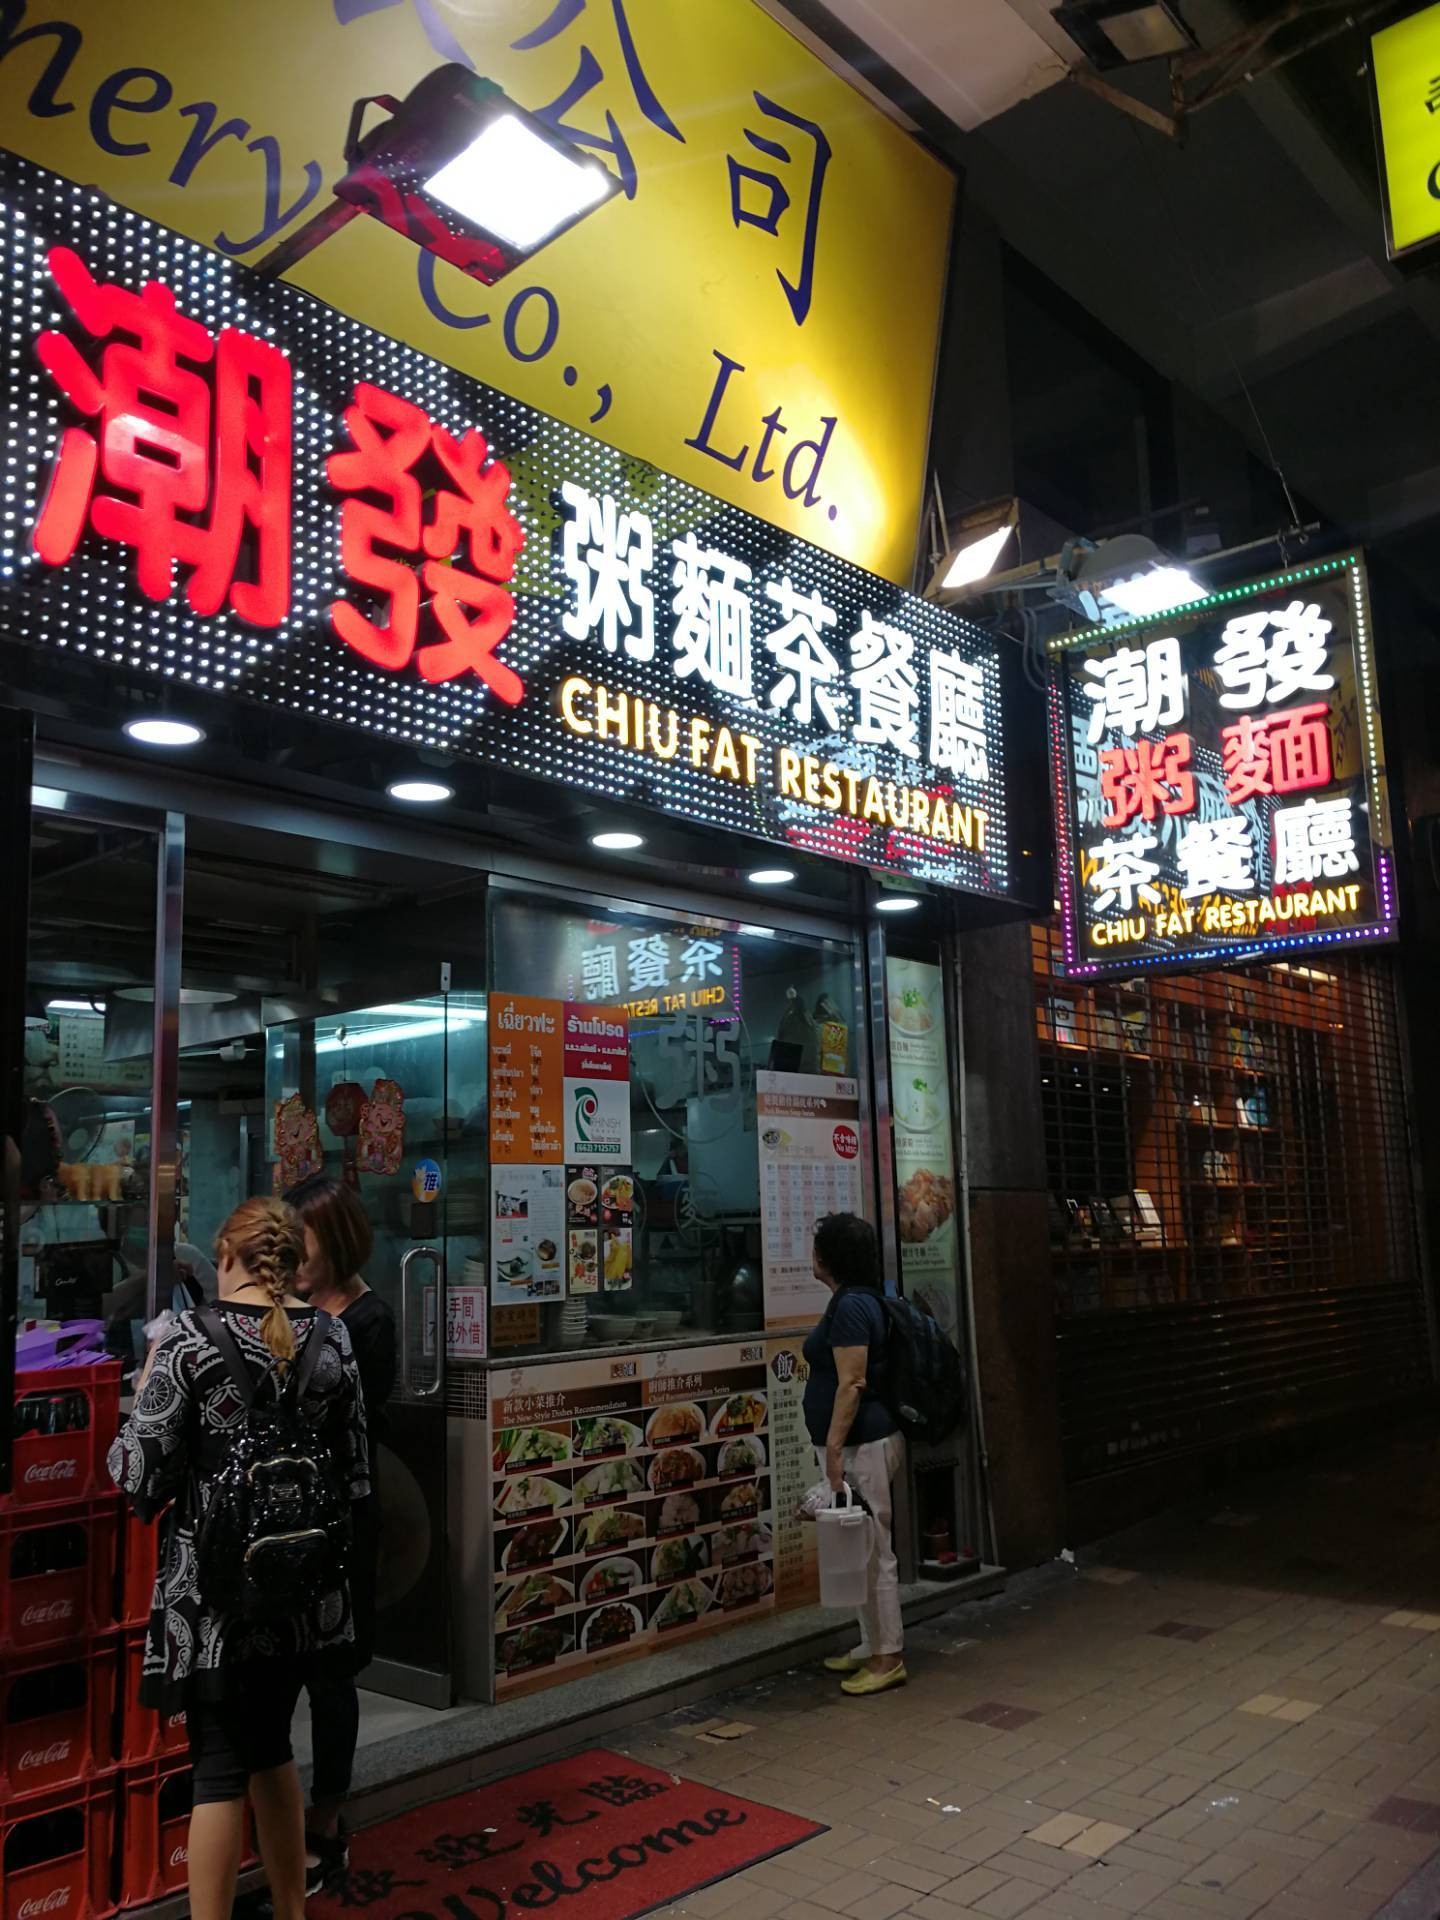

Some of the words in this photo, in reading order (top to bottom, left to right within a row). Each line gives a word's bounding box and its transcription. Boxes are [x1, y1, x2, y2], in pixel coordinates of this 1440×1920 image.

[418, 247, 612, 424] Co.,
[684, 348, 838, 521] Ltd.
[32, 245, 525, 705] 潮發
[1083, 600, 1335, 744] 潮發
[560, 677, 679, 759] CHIU
[691, 718, 762, 785] FAT
[780, 747, 990, 852] RESTAURANT
[1101, 701, 1333, 828] 粥麵
[1088, 797, 1359, 912] 茶餐廳
[1091, 917, 1146, 947] CHIU
[1155, 909, 1196, 937] FAT
[1205, 885, 1361, 931] RESTAURANT
[24, 1459, 77, 1484] Coca-Cola
[20, 1599, 74, 1626] Coca-Cola
[17, 1740, 71, 1771] Coca-Cola
[16, 1886, 71, 1918] Coca-Cola
